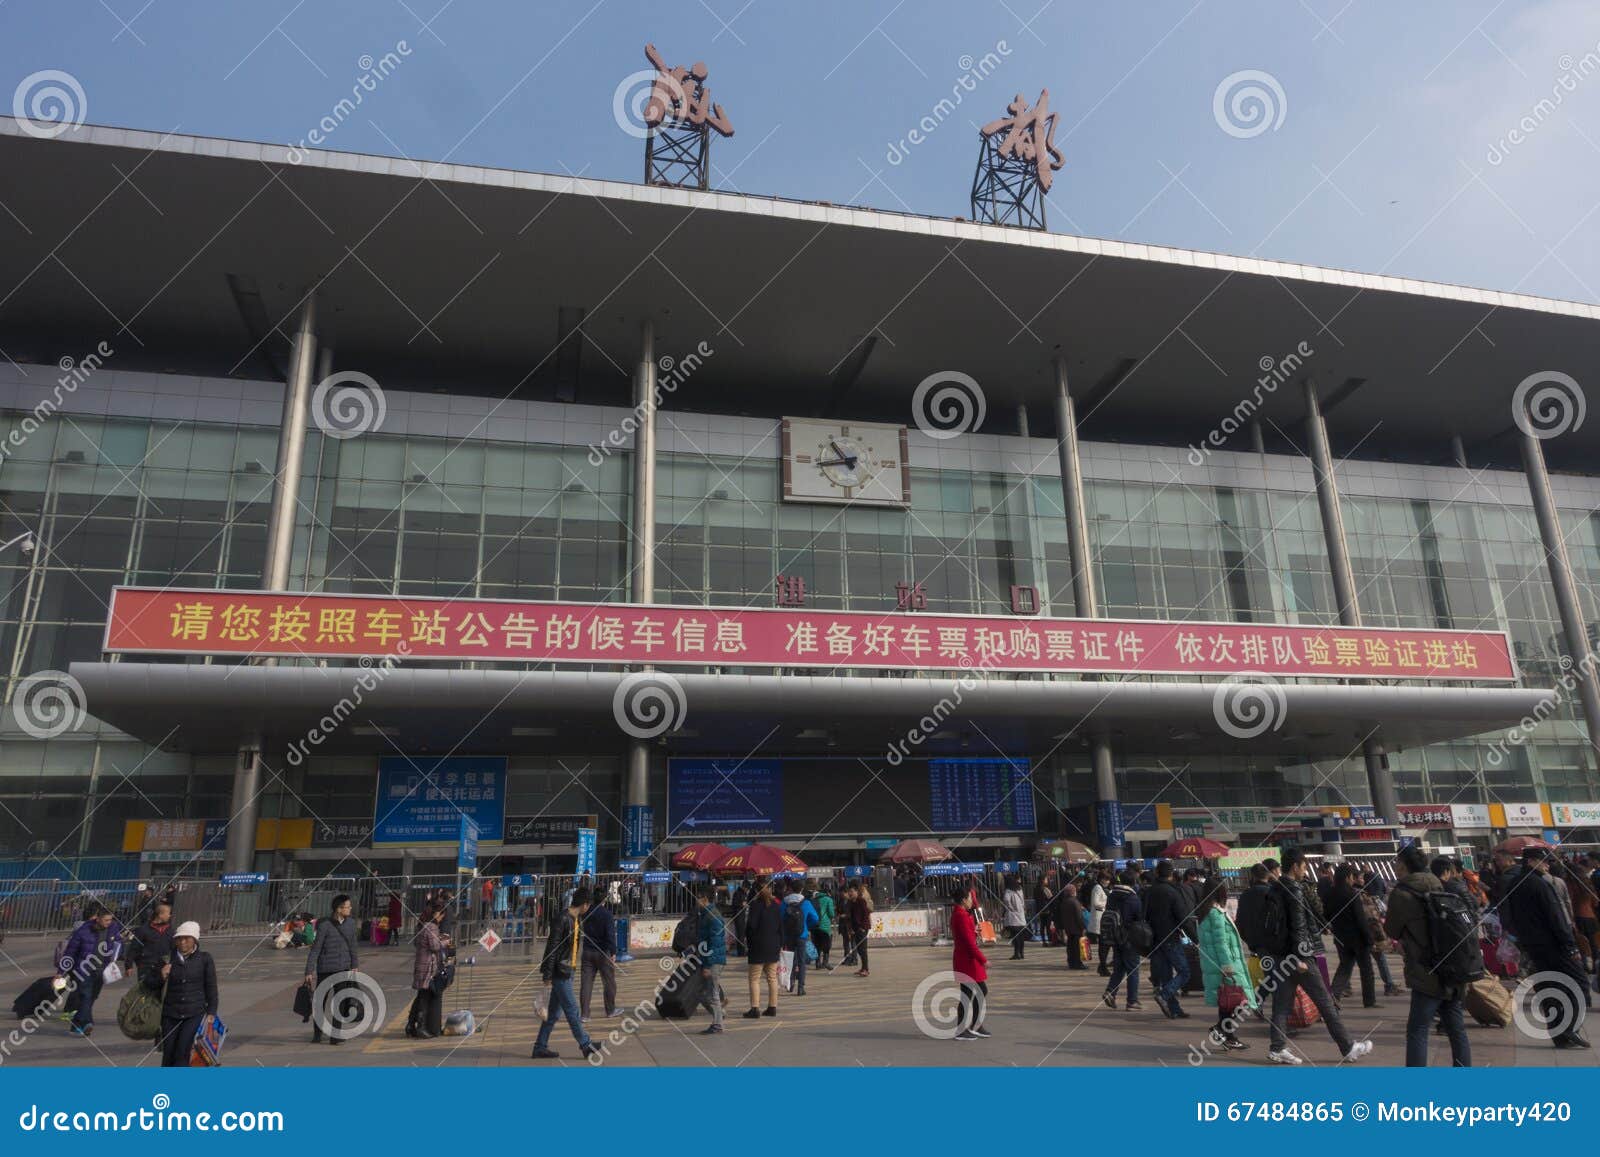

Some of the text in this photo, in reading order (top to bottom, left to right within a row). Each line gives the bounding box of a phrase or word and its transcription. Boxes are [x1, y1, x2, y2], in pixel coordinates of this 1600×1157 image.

[170, 602, 1480, 671] 请您按照车站公告的候车信息 准备好车票和购票证件 依次排队验票验证进站
[1217, 810, 1269, 825] 食品超市
